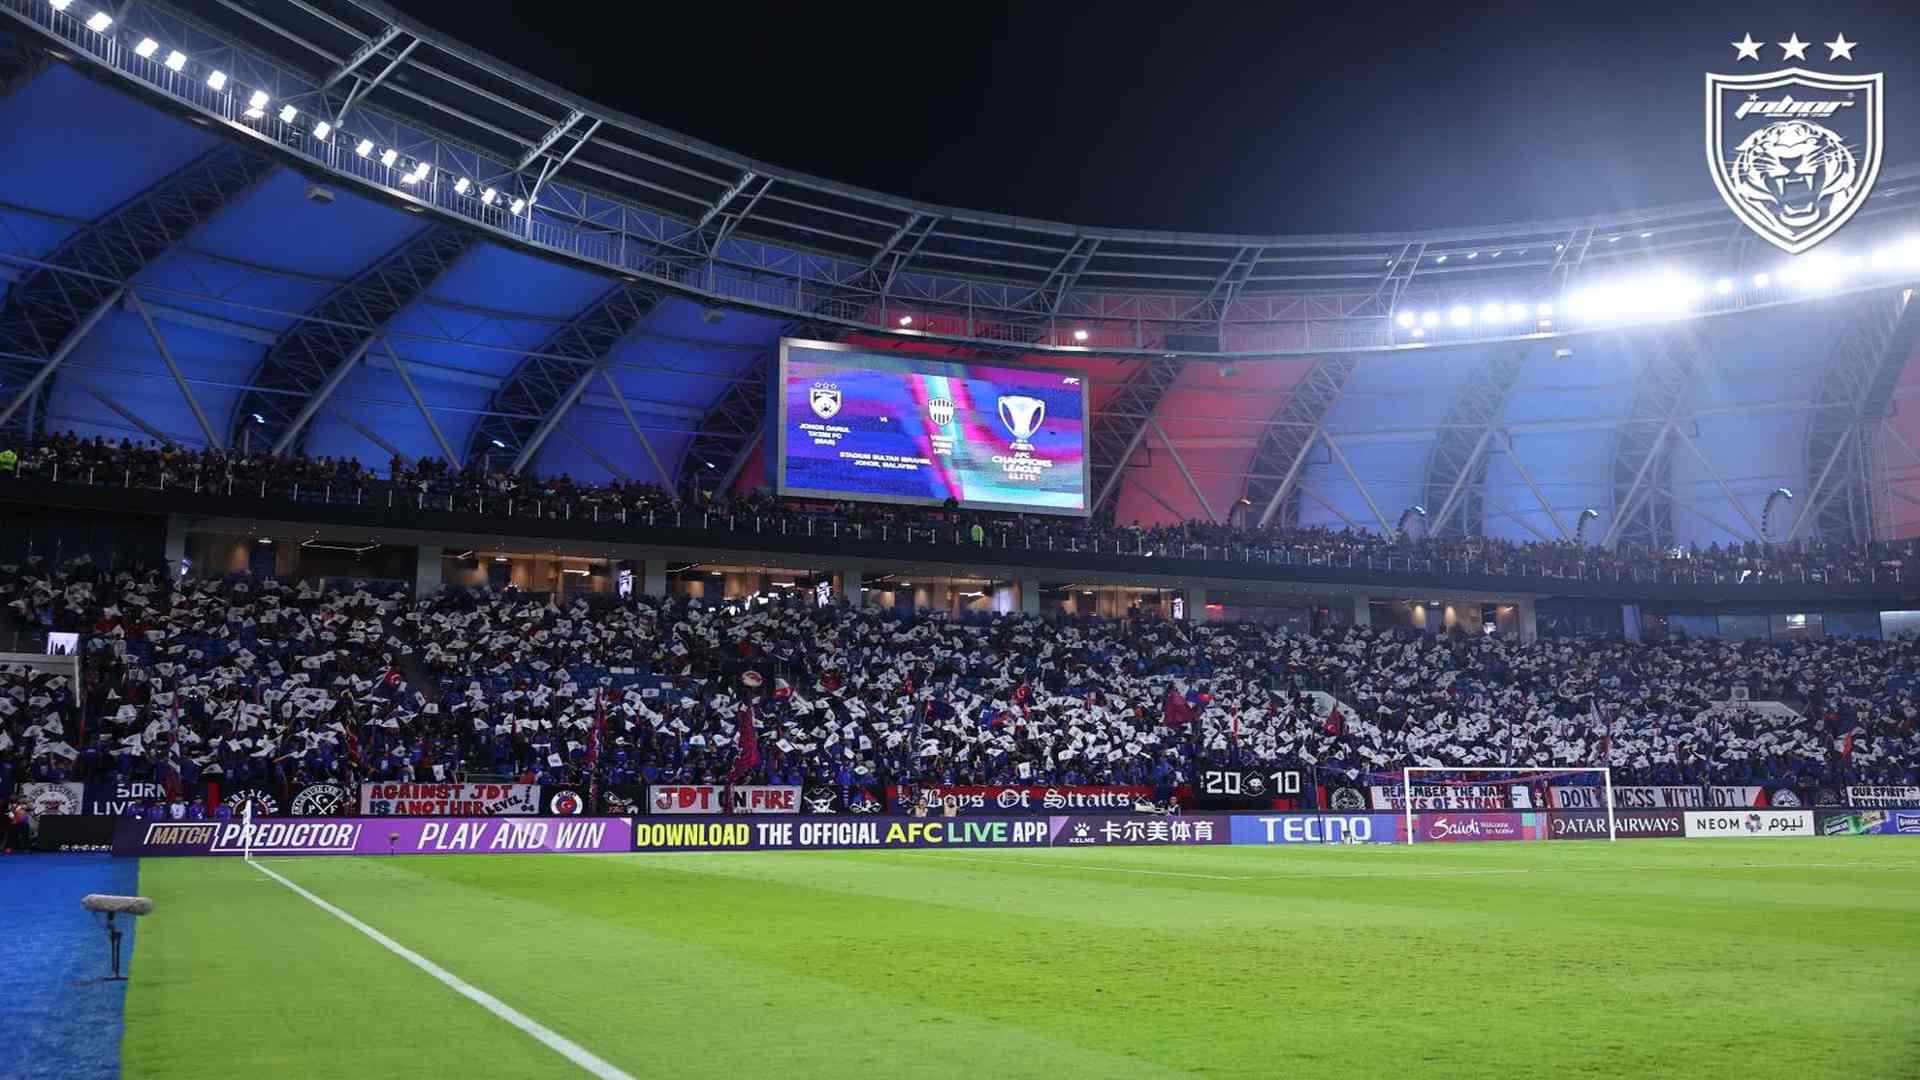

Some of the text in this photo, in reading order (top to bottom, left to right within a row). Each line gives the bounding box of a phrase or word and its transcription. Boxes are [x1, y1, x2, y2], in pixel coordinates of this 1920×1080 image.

[991, 455, 1053, 467] CHAMPIONS
[1003, 464, 1041, 474] LEAGUE
[1008, 472, 1037, 480] ELITE
[1206, 771, 1300, 794] 20 10
[371, 784, 513, 799] AGAINST JDT
[656, 787, 713, 809] JDT
[752, 790, 794, 809] FIRE
[997, 788, 1030, 809] Of
[1043, 788, 1131, 809] Straits
[1454, 786, 1475, 797] THE
[1560, 788, 1597, 807] DON'
[1614, 787, 1656, 807] MESS
[1661, 787, 1702, 807] WITH
[1873, 786, 1906, 798] SPIRIT
[370, 800, 485, 815] IS ANOTHER
[1434, 797, 1451, 809] OF
[1099, 820, 1214, 842] 卡尔美体育
[1259, 817, 1372, 842] TECNO
[1429, 818, 1480, 839] Saudi
[1552, 817, 1680, 834] QATAR AIRWAYS
[1697, 818, 1740, 830] NEOM
[1769, 815, 1804, 832] نيوم
[153, 823, 354, 847] MATCH PREDICTOR
[417, 823, 606, 849] PLAY AND WIN
[637, 822, 1048, 846] DOWNLOAD THE OFFICIAL AFC LIVE APP
